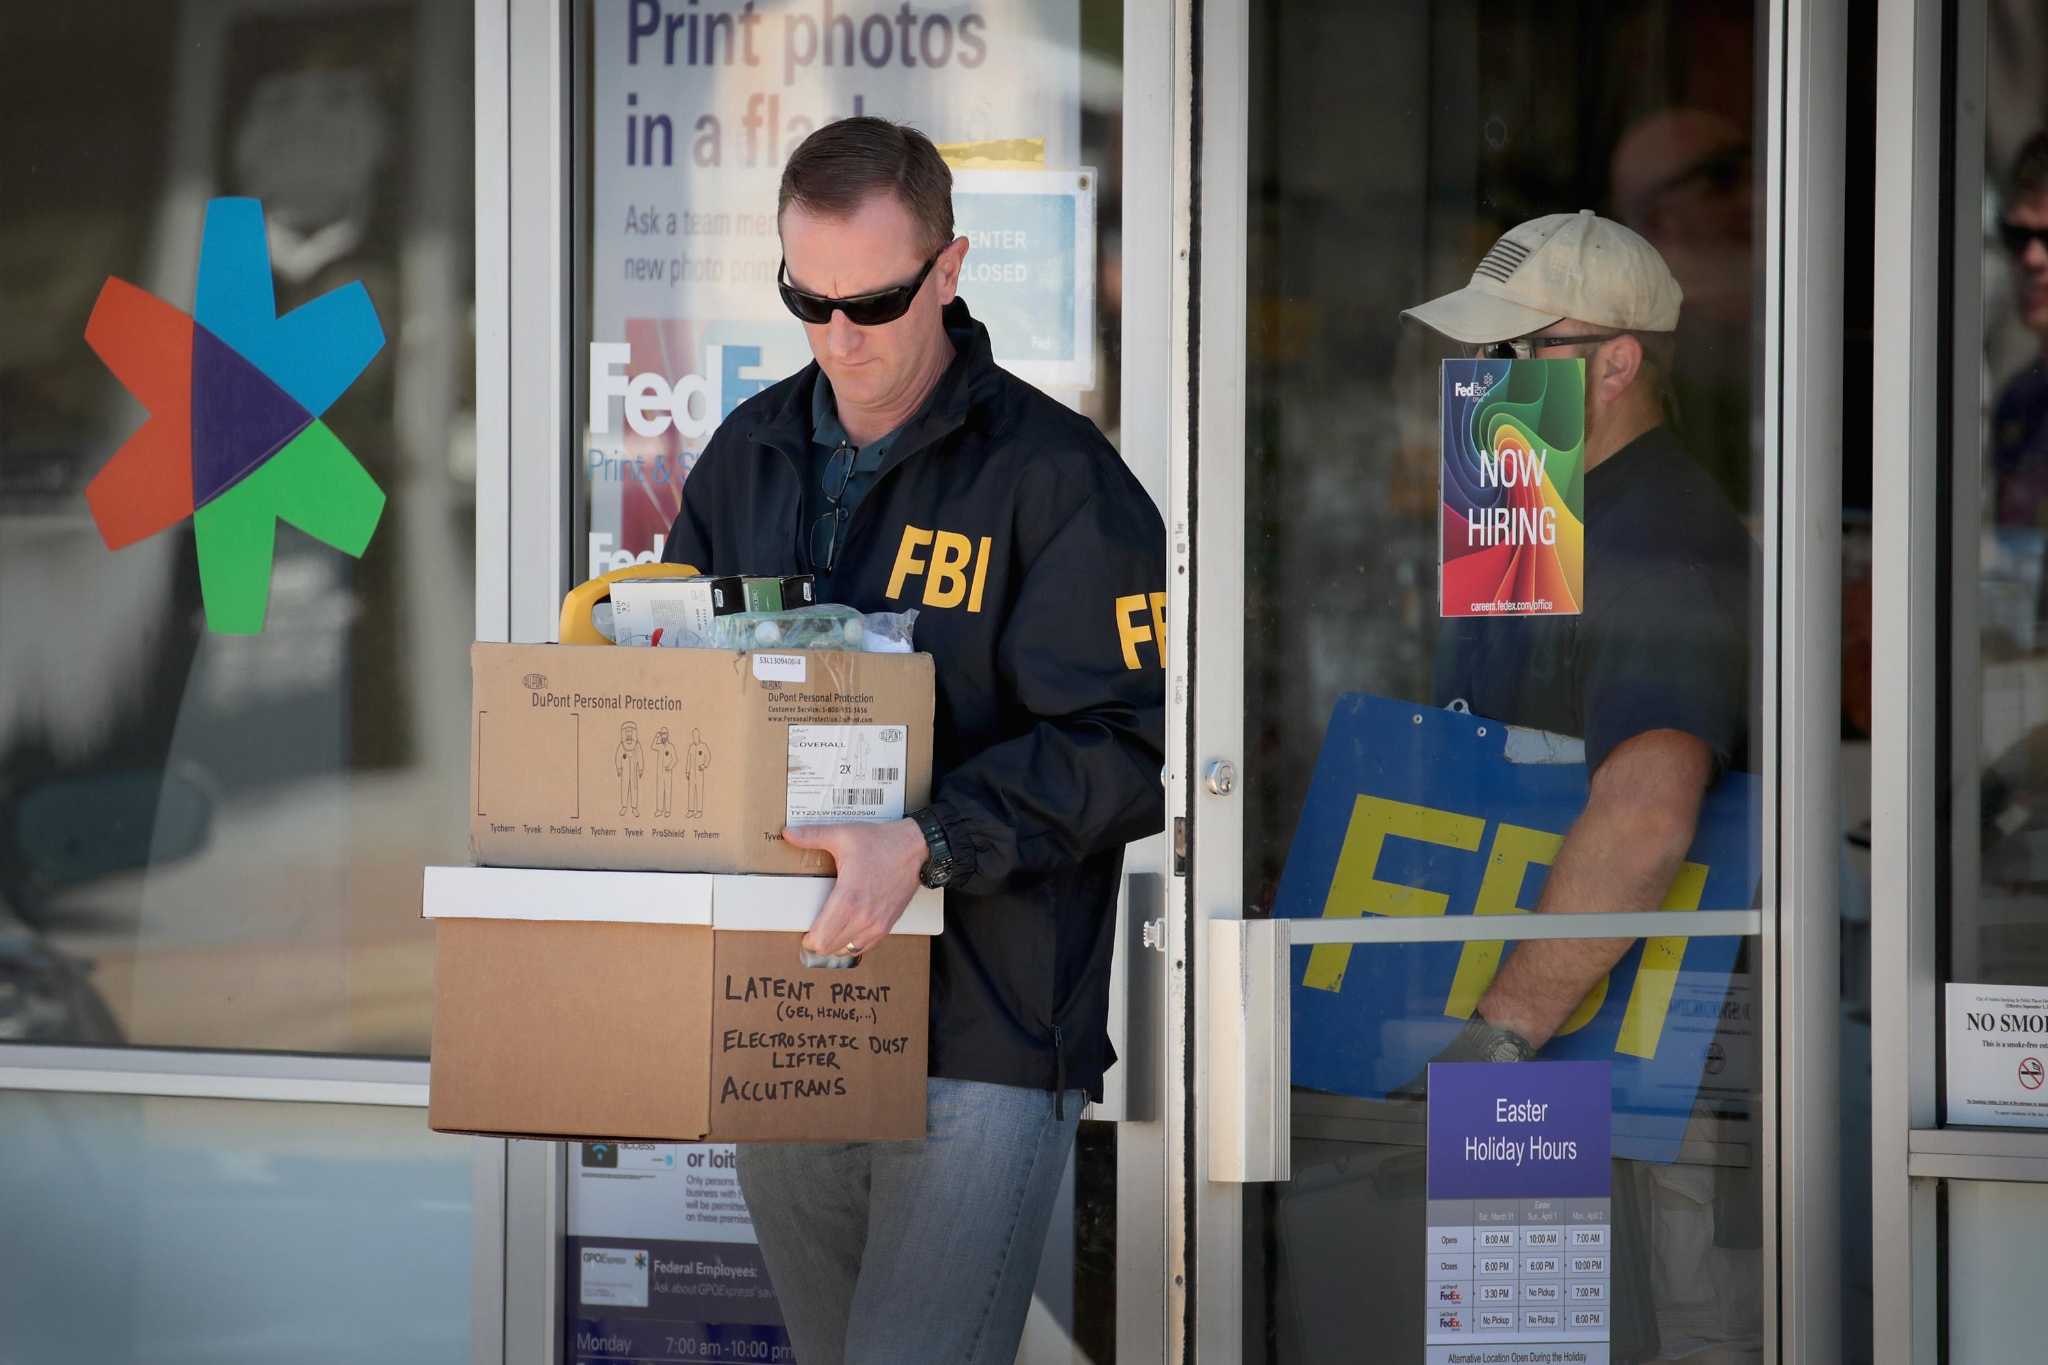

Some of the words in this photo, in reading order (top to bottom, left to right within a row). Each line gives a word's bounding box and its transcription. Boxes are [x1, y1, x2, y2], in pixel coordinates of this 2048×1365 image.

[624, 0, 763, 67] Print
[784, 0, 987, 87] photos
[625, 92, 674, 167] in
[692, 114, 722, 168] a
[741, 93, 864, 168] fla
[624, 203, 661, 235] Ask
[665, 212, 678, 235] a
[682, 209, 730, 235] team
[965, 229, 1027, 249] ENTER
[624, 256, 664, 280] new
[670, 250, 721, 287] photo
[590, 343, 780, 438] FedE
[588, 449, 645, 481] Print
[1480, 448, 1547, 488] NOW
[1468, 506, 1557, 547] HIRING
[885, 524, 992, 613] FBI
[532, 692, 570, 708] DuPont
[574, 693, 622, 709] Personal
[625, 695, 682, 711] Protection
[768, 692, 797, 702] DuPont
[799, 692, 832, 703] Personal
[834, 692, 874, 703] Protection
[840, 764, 851, 775] 2X
[490, 824, 515, 834] Tychem
[523, 824, 542, 834] Tyvek
[549, 825, 582, 835] ProShield
[590, 826, 616, 836] Tychem
[624, 827, 643, 837] Tyvek
[652, 828, 685, 838] ProShield
[693, 830, 720, 840] Tychem
[725, 974, 815, 1003] LATENT
[830, 982, 891, 1004] PRINT
[1966, 1012, 1995, 1032] NO
[722, 1029, 860, 1053] ELECTROSTATIC
[868, 1035, 909, 1055] DUST
[1982, 1039, 1994, 1047] This
[2007, 1040, 2038, 1048] smoke-free
[772, 1051, 840, 1070] LIFTER
[720, 1076, 847, 1104] ACCUTRANS
[1496, 1098, 1548, 1123] Easter
[687, 1151, 704, 1168] or
[709, 1149, 737, 1169] loit
[1465, 1136, 1525, 1167] Holiday
[1530, 1136, 1577, 1160] Hours
[686, 1174, 703, 1187] Only
[705, 1177, 735, 1187] persons
[686, 1187, 718, 1199] business
[1441, 1235, 1458, 1246] Opens
[1499, 1235, 1510, 1244] AM
[1529, 1234, 1545, 1243] 10:00
[1546, 1234, 1557, 1243] AM
[1576, 1233, 1589, 1242] 7:00
[1590, 1233, 1600, 1242] AM
[653, 1260, 694, 1274] Federal
[1499, 1262, 1509, 1271] PM
[1544, 1261, 1555, 1270] PM
[1575, 1260, 1590, 1270] 10:00
[1591, 1260, 1602, 1270] PM
[1499, 1290, 1509, 1299] PM
[1528, 1288, 1535, 1296] No
[1536, 1288, 1556, 1297] Pickup
[1576, 1288, 1589, 1297] 7:00
[1590, 1288, 1600, 1297] PM
[1483, 1317, 1490, 1325] No
[1491, 1317, 1510, 1326] Pickup
[1528, 1316, 1535, 1324] No
[1536, 1316, 1556, 1325] Pickup
[1590, 1315, 1600, 1323] PM
[576, 1333, 632, 1355] Monday
[665, 1336, 696, 1355] 7:00
[700, 1341, 721, 1356] am
[1448, 1353, 1481, 1363] Alternative
[1482, 1353, 1510, 1363] Location
[1511, 1353, 1528, 1365] Open
[1530, 1352, 1551, 1364] During
[1552, 1352, 1562, 1362] the
[1563, 1352, 1587, 1364] Holiday
